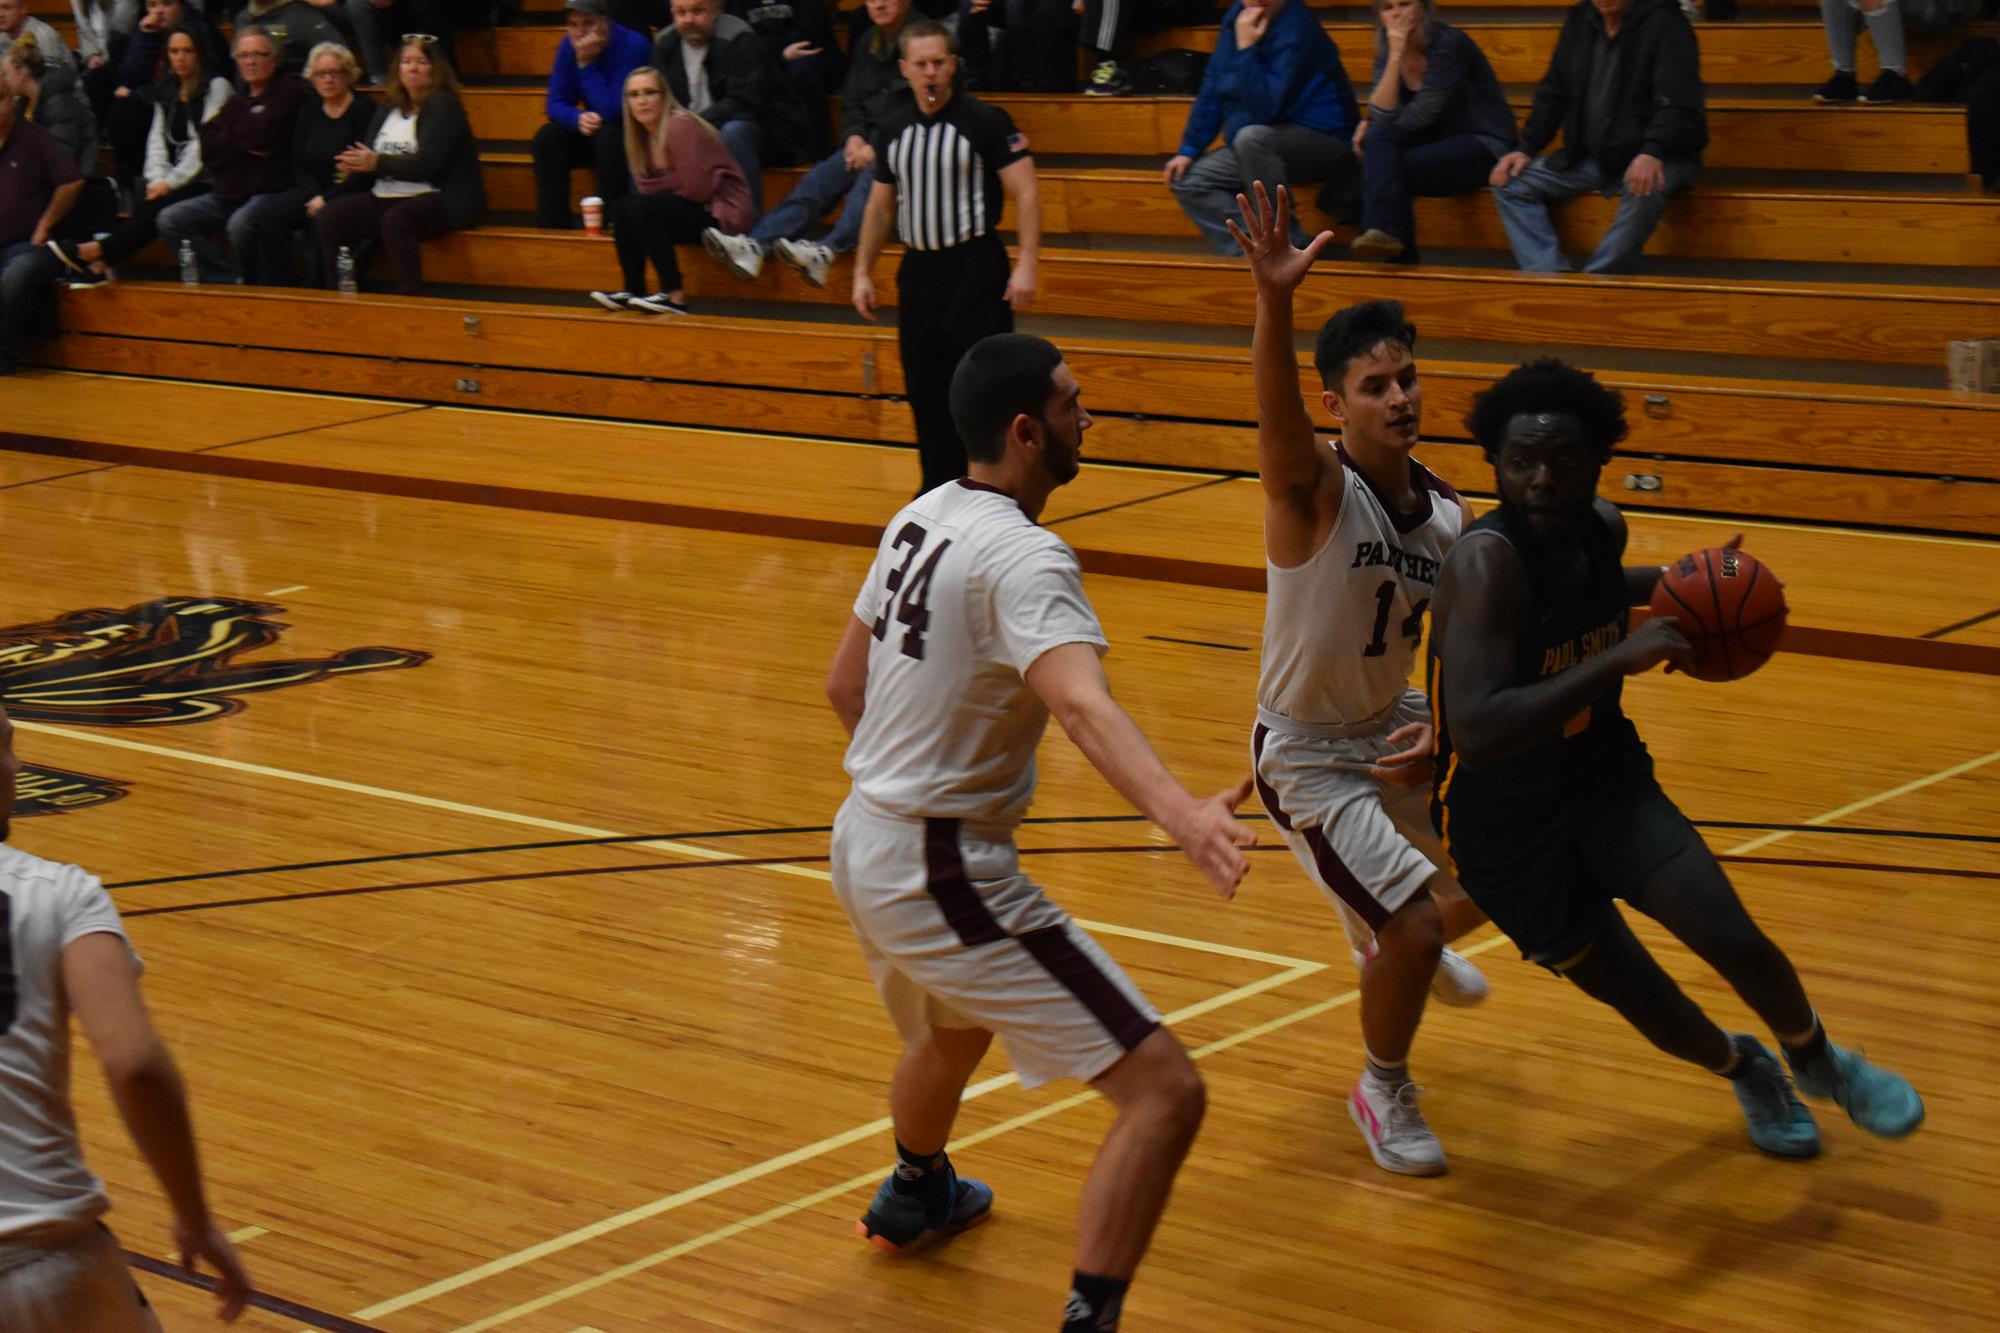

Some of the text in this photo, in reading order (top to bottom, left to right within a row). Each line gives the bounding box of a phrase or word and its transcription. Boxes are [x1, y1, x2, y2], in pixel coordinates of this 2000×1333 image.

[872, 521, 952, 660] 34
[1363, 580, 1430, 656] 14
[1541, 639, 1578, 675] PAUL
